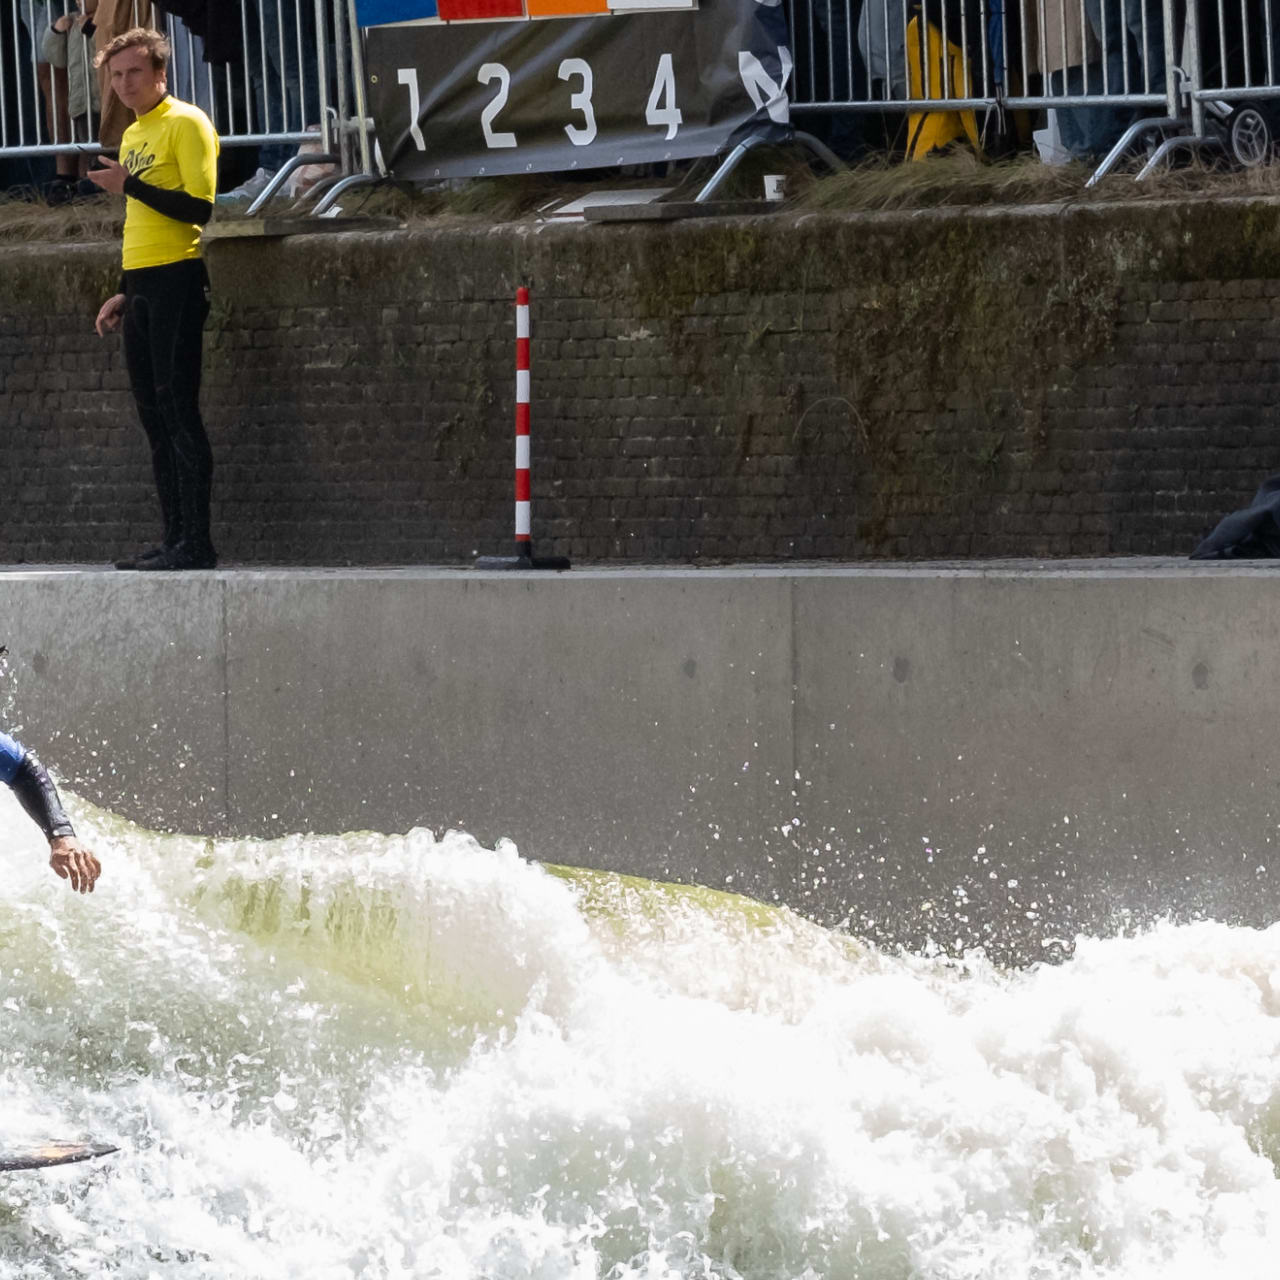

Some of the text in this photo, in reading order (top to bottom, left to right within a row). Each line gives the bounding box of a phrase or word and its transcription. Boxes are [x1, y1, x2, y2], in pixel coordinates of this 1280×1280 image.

[397, 68, 426, 151] 1
[477, 63, 518, 148] 2
[558, 58, 597, 146] 3
[645, 53, 683, 140] 4
